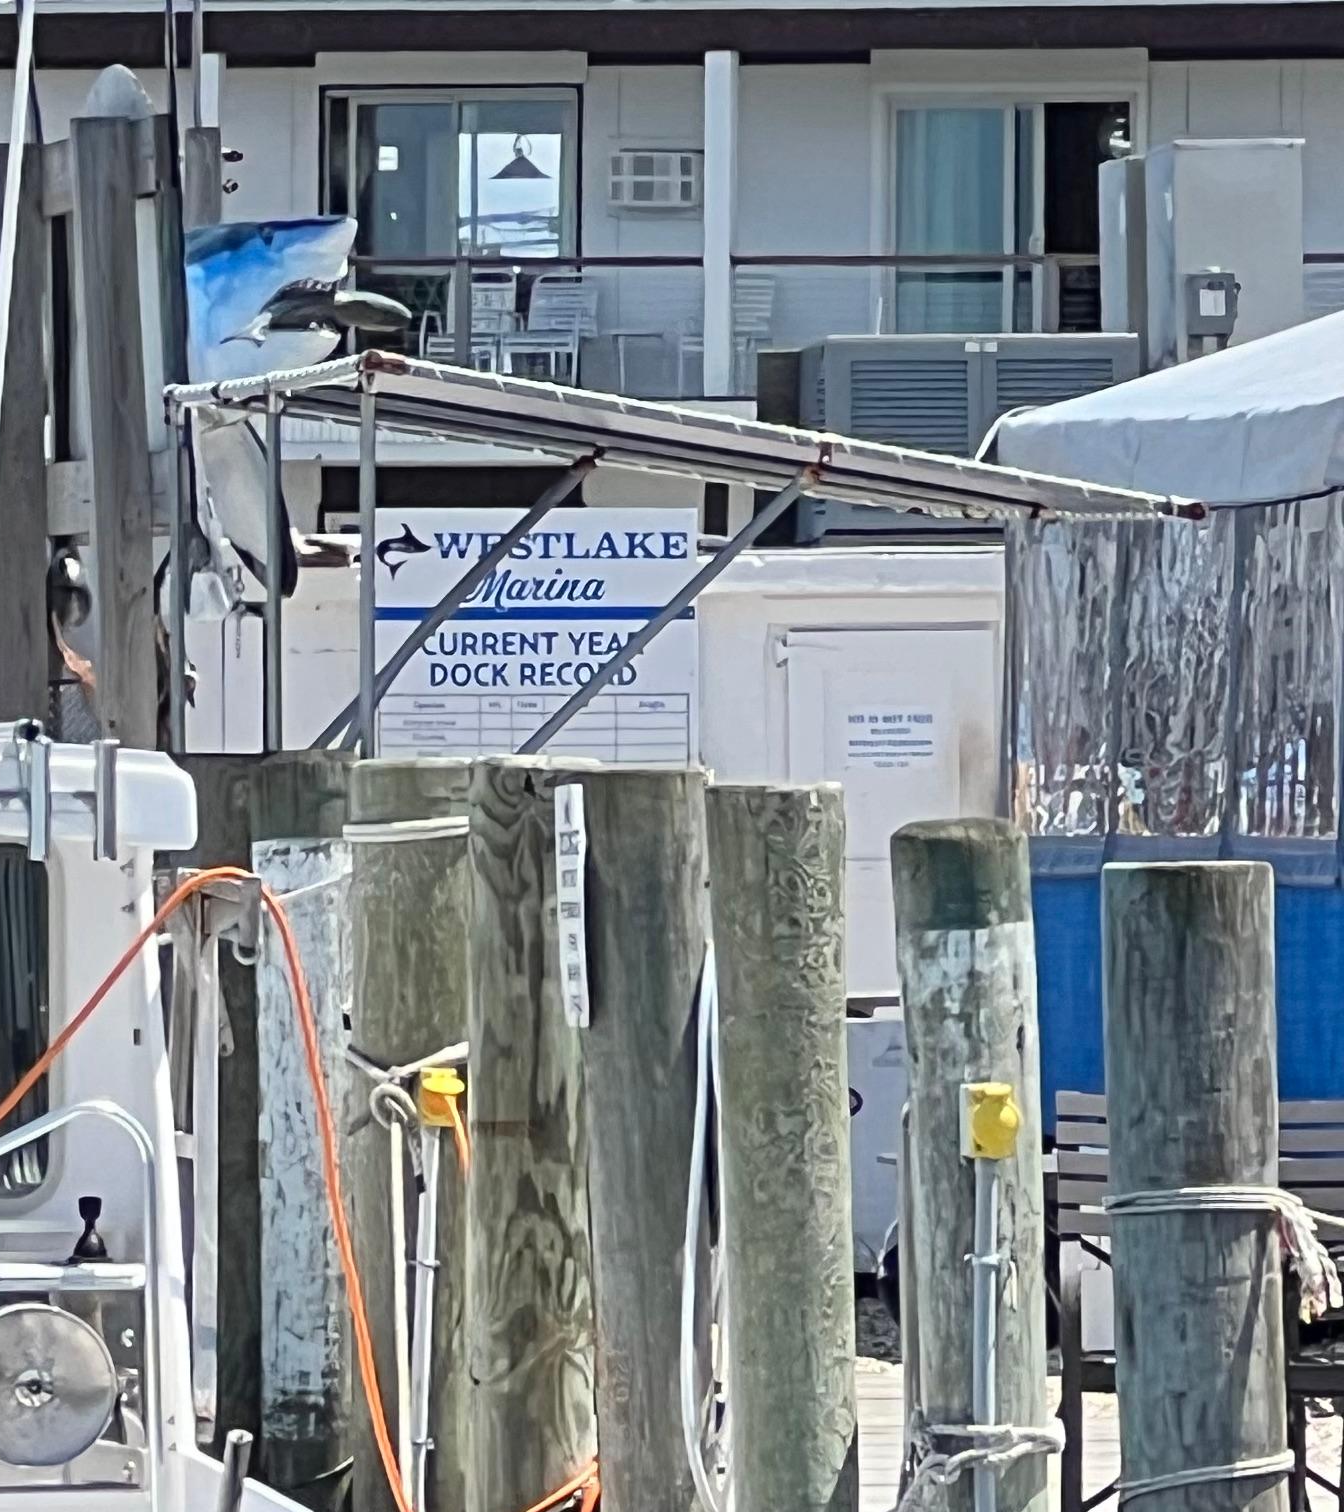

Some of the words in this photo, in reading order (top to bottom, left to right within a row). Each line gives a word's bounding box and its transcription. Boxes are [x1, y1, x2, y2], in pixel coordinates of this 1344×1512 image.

[433, 532, 689, 560] WESTLAKE
[460, 568, 606, 612] Marina
[422, 631, 559, 656] CURRENT
[429, 662, 510, 687] DOCK
